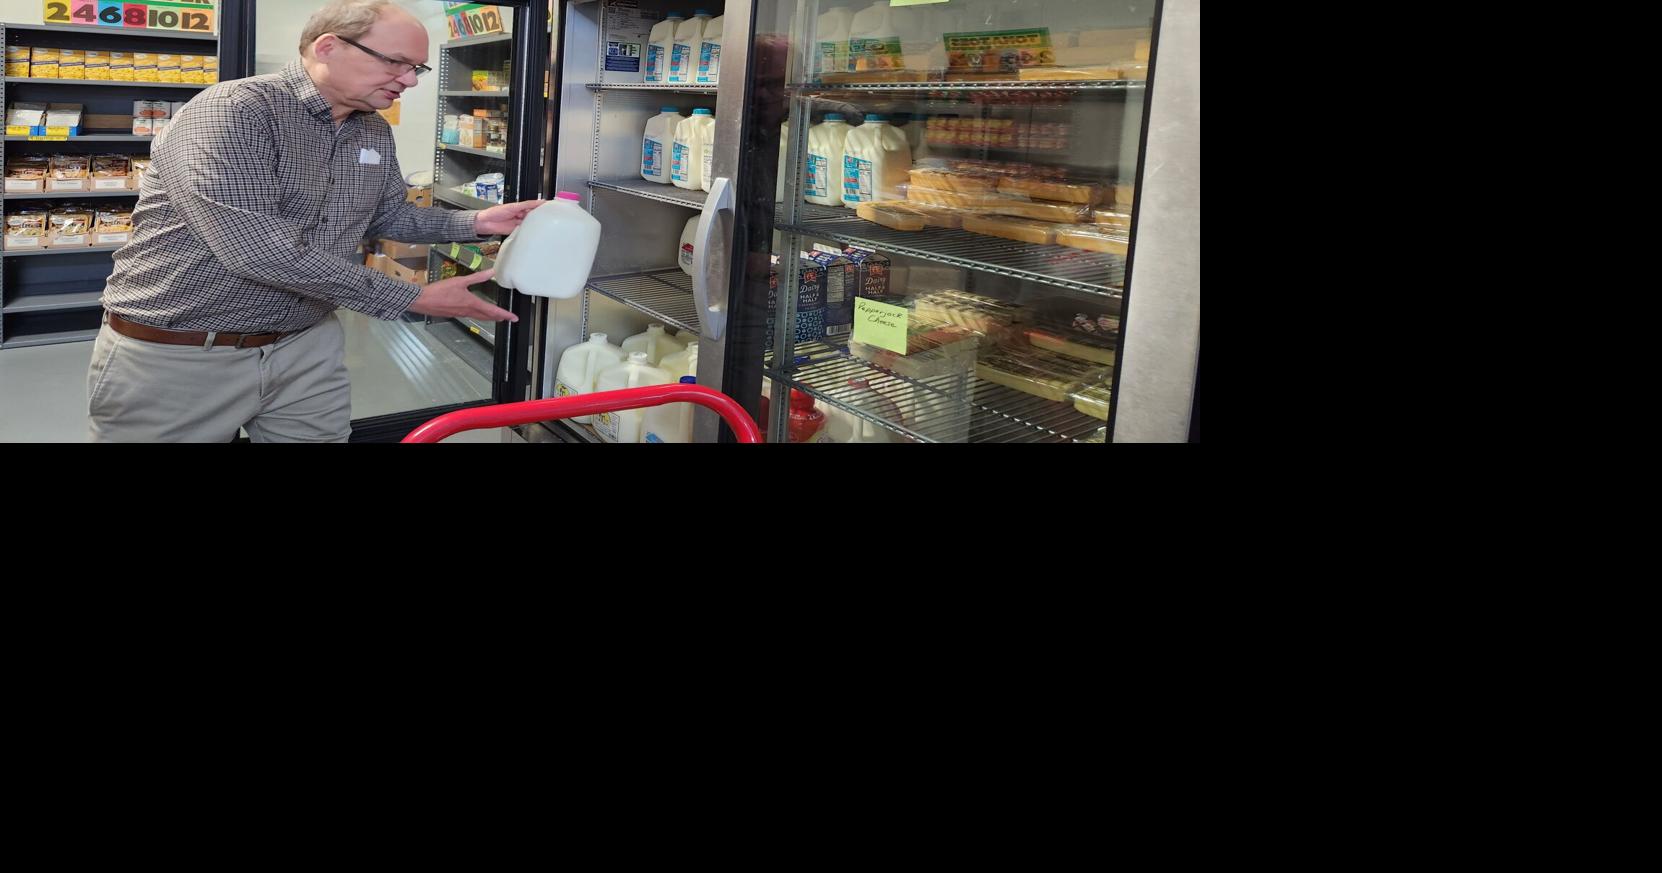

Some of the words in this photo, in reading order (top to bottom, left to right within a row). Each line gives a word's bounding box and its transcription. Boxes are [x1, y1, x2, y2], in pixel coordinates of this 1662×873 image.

[47, 2, 70, 21] 2
[73, 4, 97, 22] 4
[99, 6, 122, 24] 6
[123, 8, 146, 25] 8
[149, 9, 179, 28] 10
[181, 12, 209, 30] 12
[468, 14, 485, 34] 10
[481, 11, 500, 32] 12
